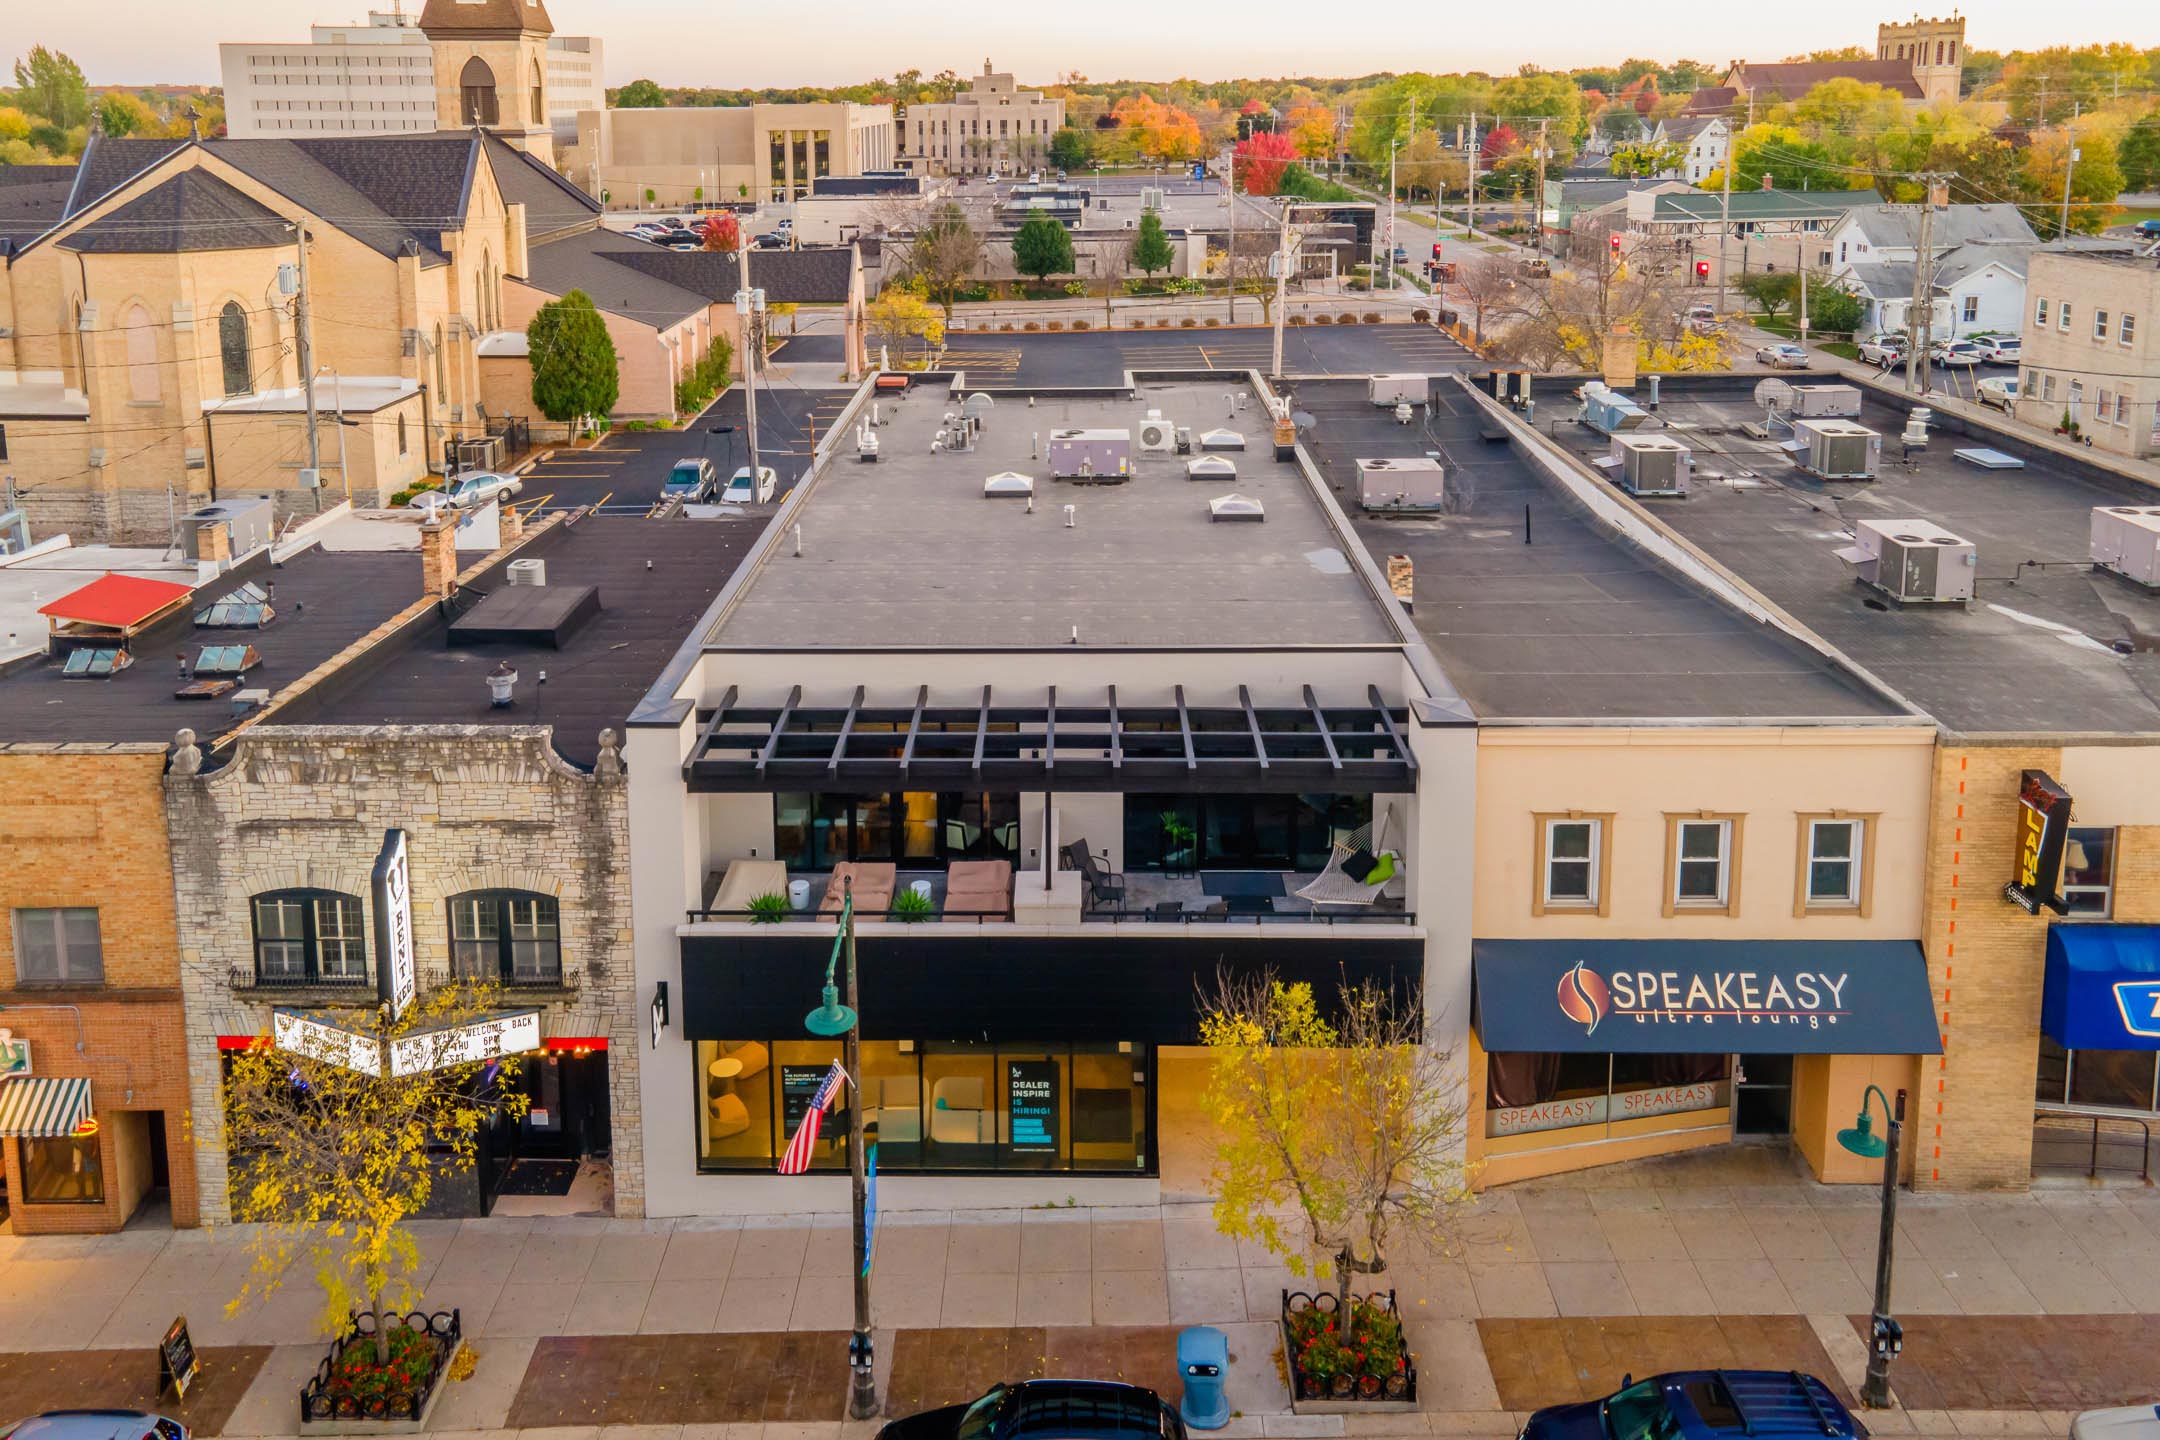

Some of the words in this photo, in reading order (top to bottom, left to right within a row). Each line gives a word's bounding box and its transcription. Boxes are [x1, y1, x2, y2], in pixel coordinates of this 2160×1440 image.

[2022, 808, 2040, 888] LAMP
[396, 911, 407, 980] BENT
[396, 979, 413, 1008] KEG
[1612, 972, 1848, 1009] SPEAKEASY
[465, 1022, 503, 1038] WELCOME
[512, 1017, 532, 1029] BACK
[1635, 1009, 1713, 1024] ultra
[1737, 1009, 1837, 1029] lounge
[1012, 1081, 1050, 1089] DEALER
[1012, 1090, 1051, 1098] INSPIRE
[1624, 1083, 1718, 1110] SPEAKEASY
[1012, 1098, 1023, 1106] IS
[1012, 1107, 1051, 1115] HIRING!
[1500, 1101, 1596, 1126] SPEAKEASY
